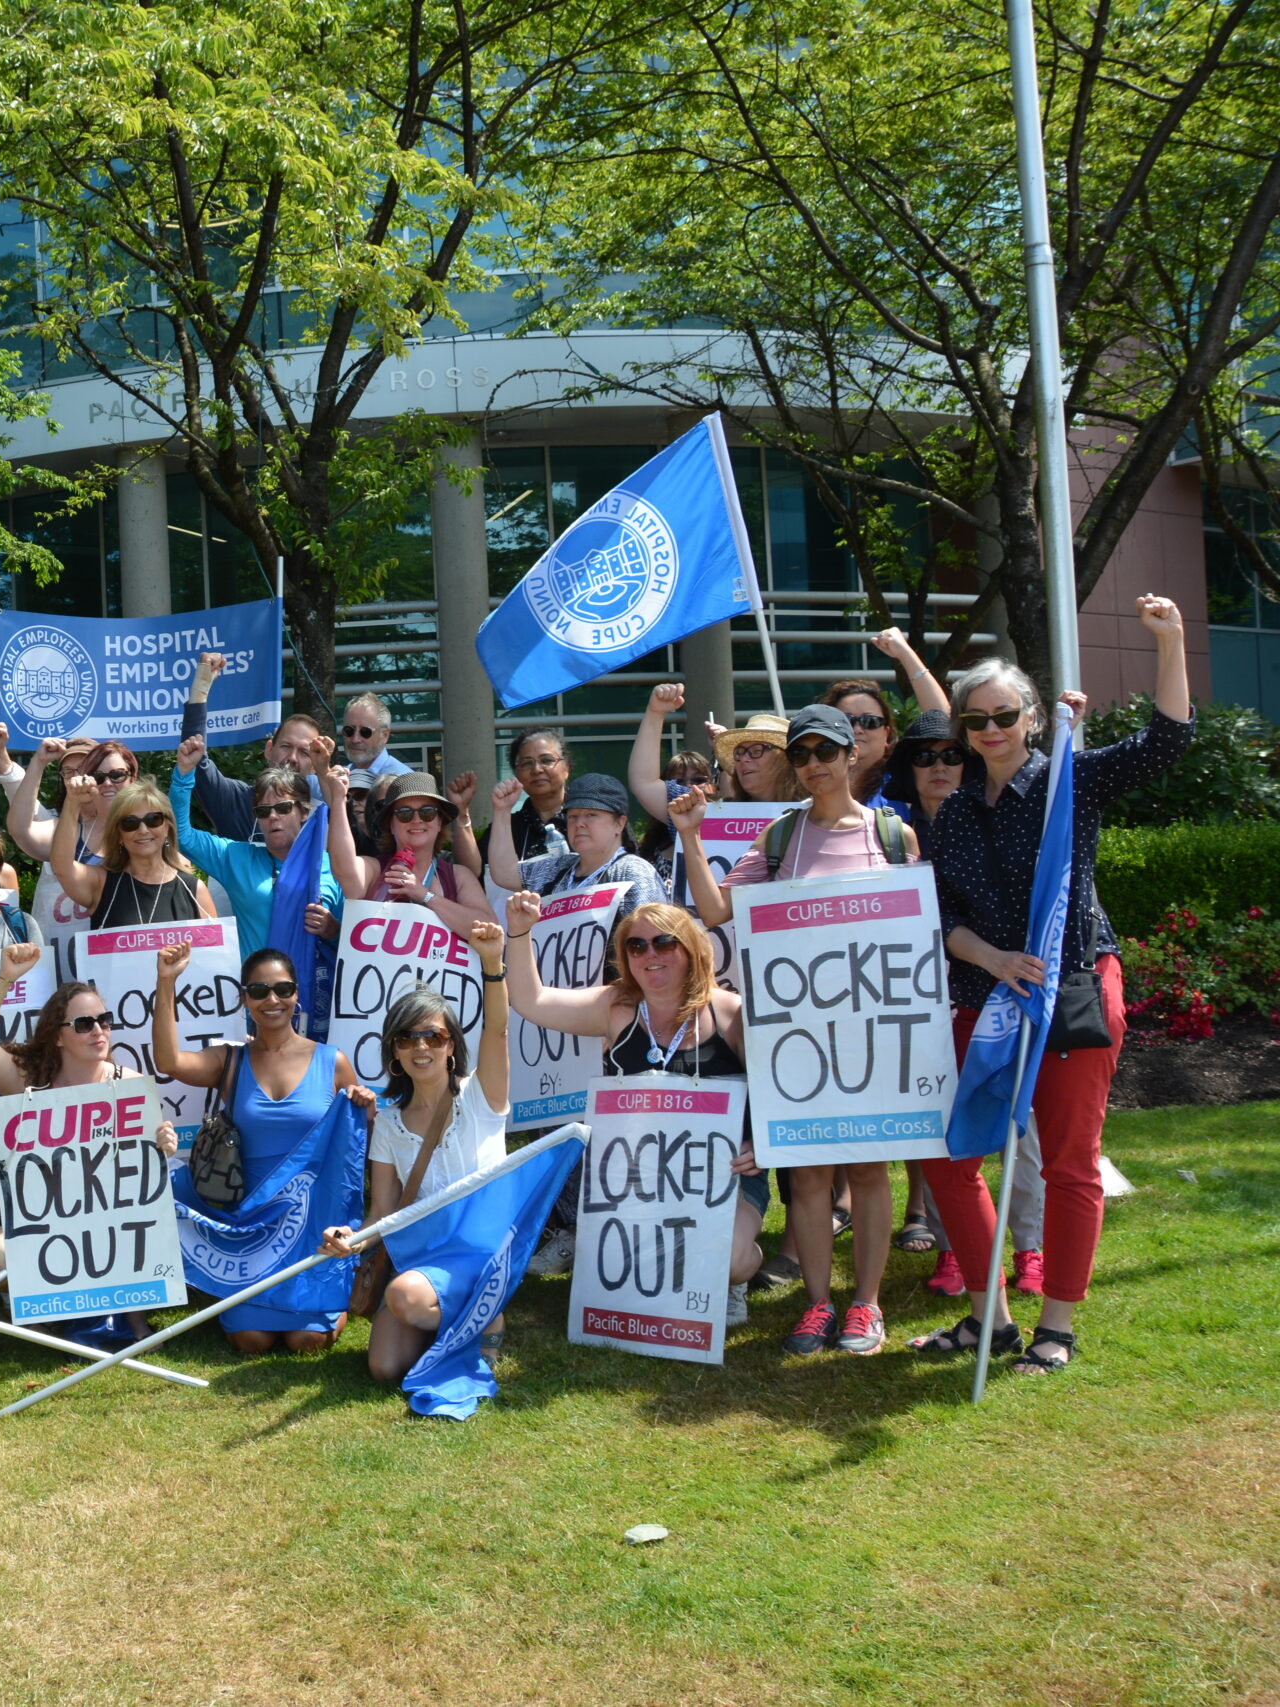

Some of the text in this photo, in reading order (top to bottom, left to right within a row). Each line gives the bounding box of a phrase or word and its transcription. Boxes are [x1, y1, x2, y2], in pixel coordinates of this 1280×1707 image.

[104, 626, 225, 656] HOSPITAL
[2, 630, 93, 717] HOSPITAL EMPLOYEES' UNION
[105, 649, 254, 684] EMPLOES'
[106, 687, 190, 712] UNION
[26, 720, 66, 736] CUPE
[107, 720, 169, 736] Working
[206, 713, 239, 729] etter
[242, 711, 260, 724] care
[724, 821, 765, 835] CUPE
[539, 895, 592, 917] CUPE 1816
[786, 897, 882, 922] CUPE 1816
[116, 930, 193, 949] CUPE 1816
[349, 917, 469, 967] CUPE
[532, 920, 608, 989] CKED
[771, 1012, 931, 1102] OUT
[917, 1074, 947, 1096] BY
[517, 1095, 588, 1118] Pacific Blue Cros
[617, 1093, 693, 1110] CUPE 1816
[3, 1095, 146, 1152] CUPE
[776, 1118, 935, 1142] Pacific Blue Cross,
[583, 1129, 738, 1213] LOCKED
[38, 1220, 157, 1285] OUT
[193, 1244, 249, 1277] CUPE
[597, 1217, 697, 1298] OUT
[20, 1288, 161, 1316] Pacific Blue Cross,
[587, 1312, 705, 1345] Pacific Blue Cross,
